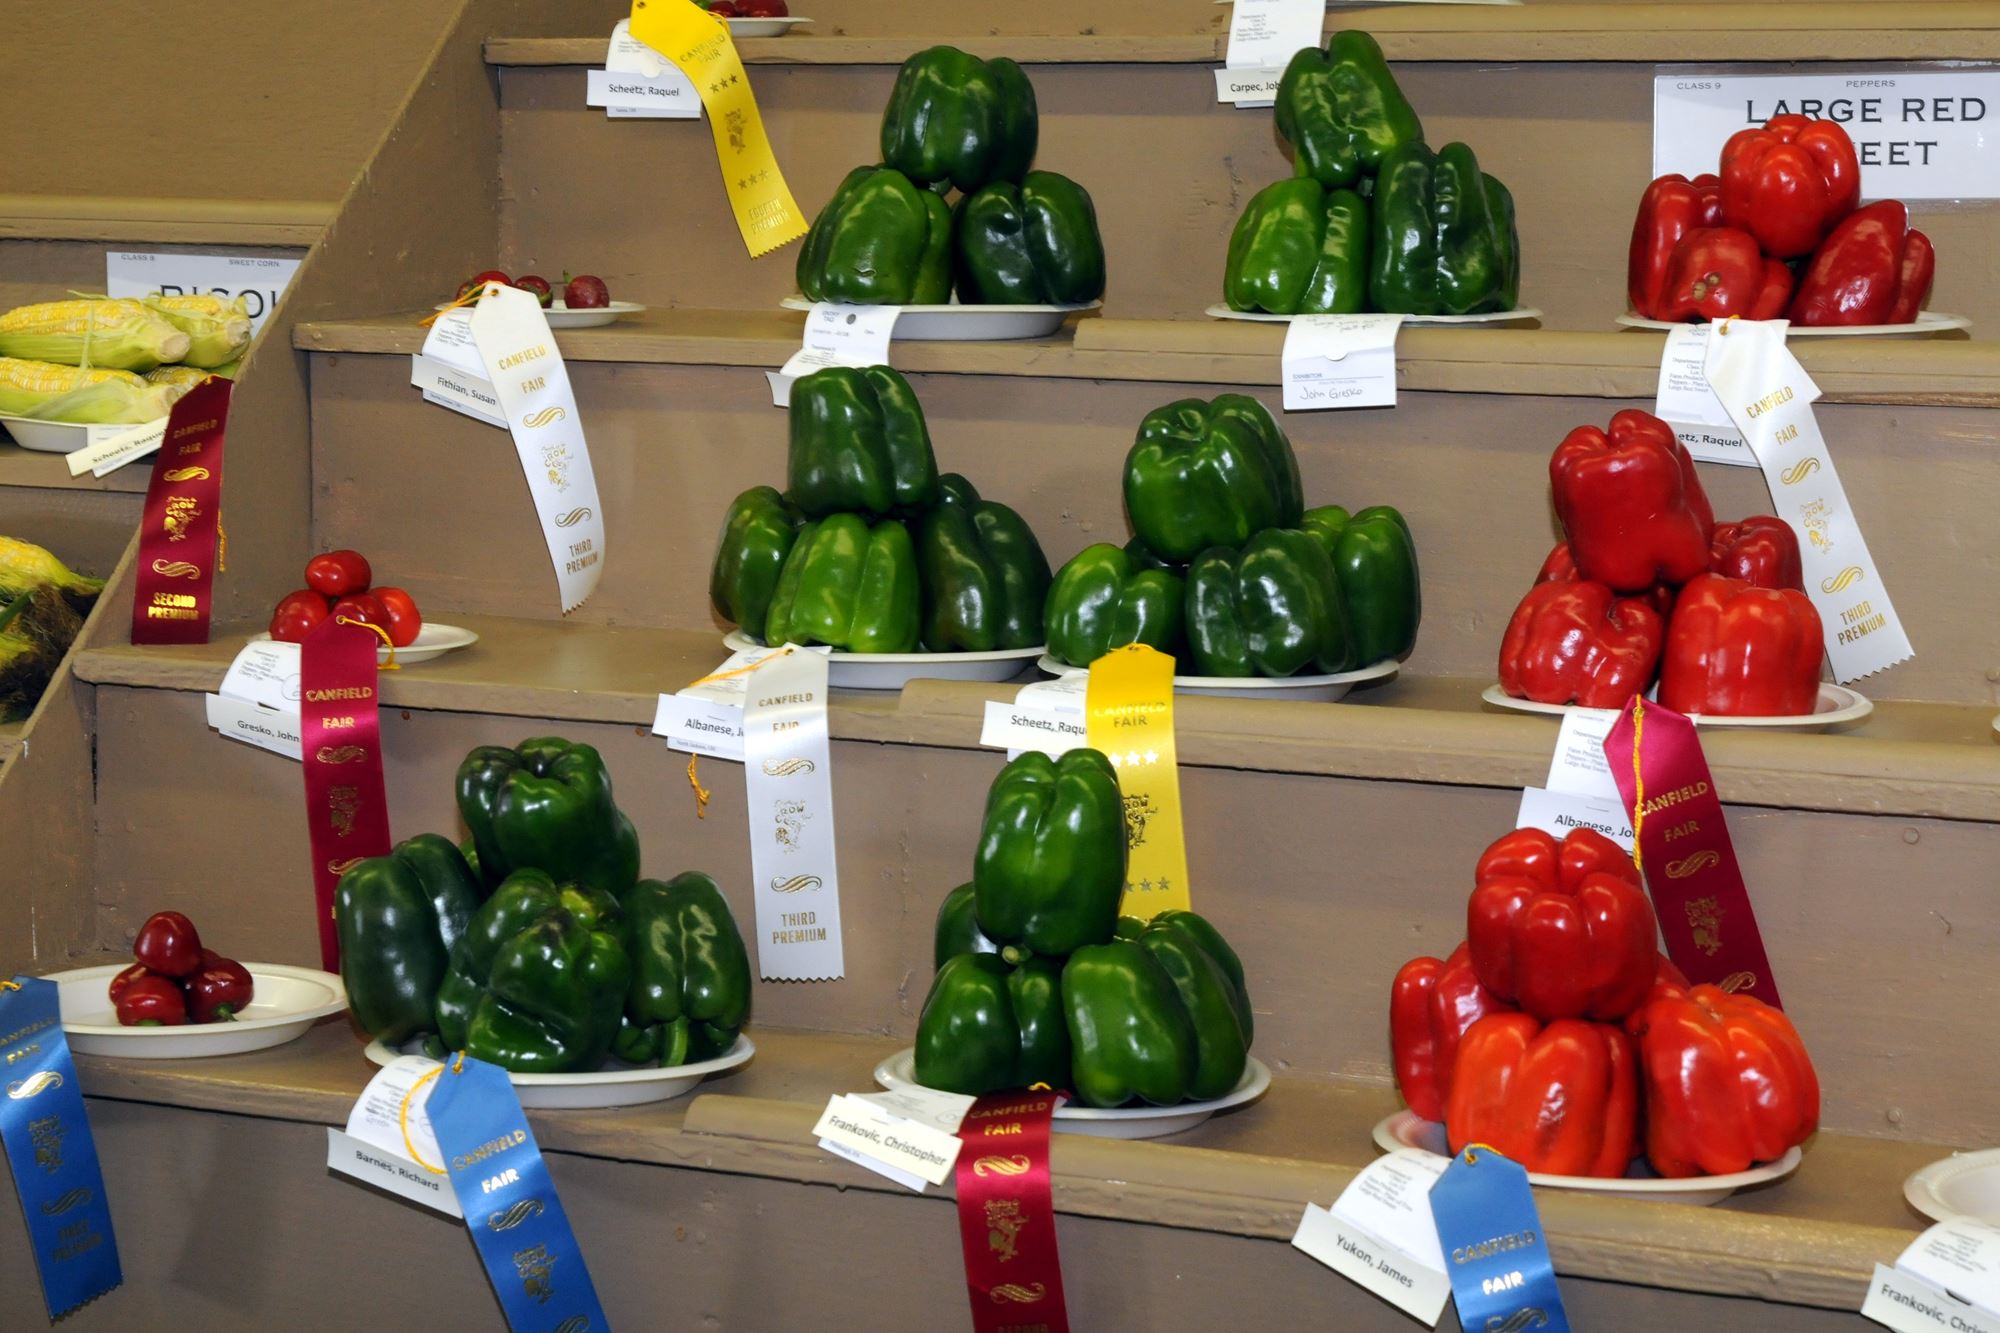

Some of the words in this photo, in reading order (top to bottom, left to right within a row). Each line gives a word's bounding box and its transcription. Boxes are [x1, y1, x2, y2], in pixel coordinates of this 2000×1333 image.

[608, 83, 646, 96] Scheetz,
[648, 86, 680, 98] Raquel
[1230, 83, 1263, 93] Carpec,
[1677, 82, 1712, 90] CLASS
[1846, 80, 1896, 88] PEPPERS
[1747, 98, 1882, 123] LARGE
[1902, 97, 1986, 121] RED
[1856, 141, 1938, 166] EET
[751, 210, 791, 235] PREMIUM
[229, 259, 255, 267] SWEET
[257, 260, 280, 268] CORN
[499, 344, 547, 370] CANFIELD
[437, 376, 468, 397] Fithian,
[471, 389, 497, 406] Susan
[521, 376, 546, 394] FAIR
[1300, 386, 1325, 401] John
[1746, 385, 1794, 419] CANFIELD
[173, 419, 218, 438] CANFIELD
[1775, 424, 1799, 445] FAIR
[178, 442, 202, 455] FAIR
[1678, 433, 1699, 444] etz,
[1702, 434, 1743, 448] Raquel
[568, 538, 592, 557] THIRD
[565, 555, 599, 575] PREMIUM
[153, 592, 197, 608] SECOND
[147, 605, 199, 621] PREMIUM
[1840, 600, 1873, 625] THIRD
[1837, 612, 1887, 645] PREMIUM
[306, 686, 373, 702] CANFIELD
[758, 693, 814, 708] CANFIELD
[237, 719, 275, 738] Gresko,
[277, 730, 300, 743] John
[322, 717, 356, 730] FAIR
[684, 718, 735, 737] Albanese,
[1011, 714, 1055, 732] Scheetz,
[1058, 721, 1088, 736] Raqu
[1113, 715, 1148, 728] FAIR
[1554, 814, 1615, 836] Albanese,
[1619, 827, 1634, 838] Jo
[1664, 821, 1700, 842] FAIR
[782, 912, 816, 927] THIRD
[773, 928, 827, 944] PREMIUM
[970, 1102, 1047, 1118] CANFIELD
[984, 1123, 1023, 1136] FAIR
[829, 1115, 880, 1144] Frankovic,
[884, 1135, 947, 1166] Christopher
[453, 1130, 526, 1171] CANFIELD
[356, 1150, 396, 1174] Barnes,
[399, 1167, 439, 1191] Richard
[481, 1169, 520, 1194] FAIR
[1452, 1231, 1536, 1265] CANFIELD
[1337, 1234, 1374, 1268] Yukon,
[1377, 1258, 1414, 1289] James
[1482, 1271, 1525, 1295] FAIR
[1881, 1283, 1946, 1325] Frankovic,
